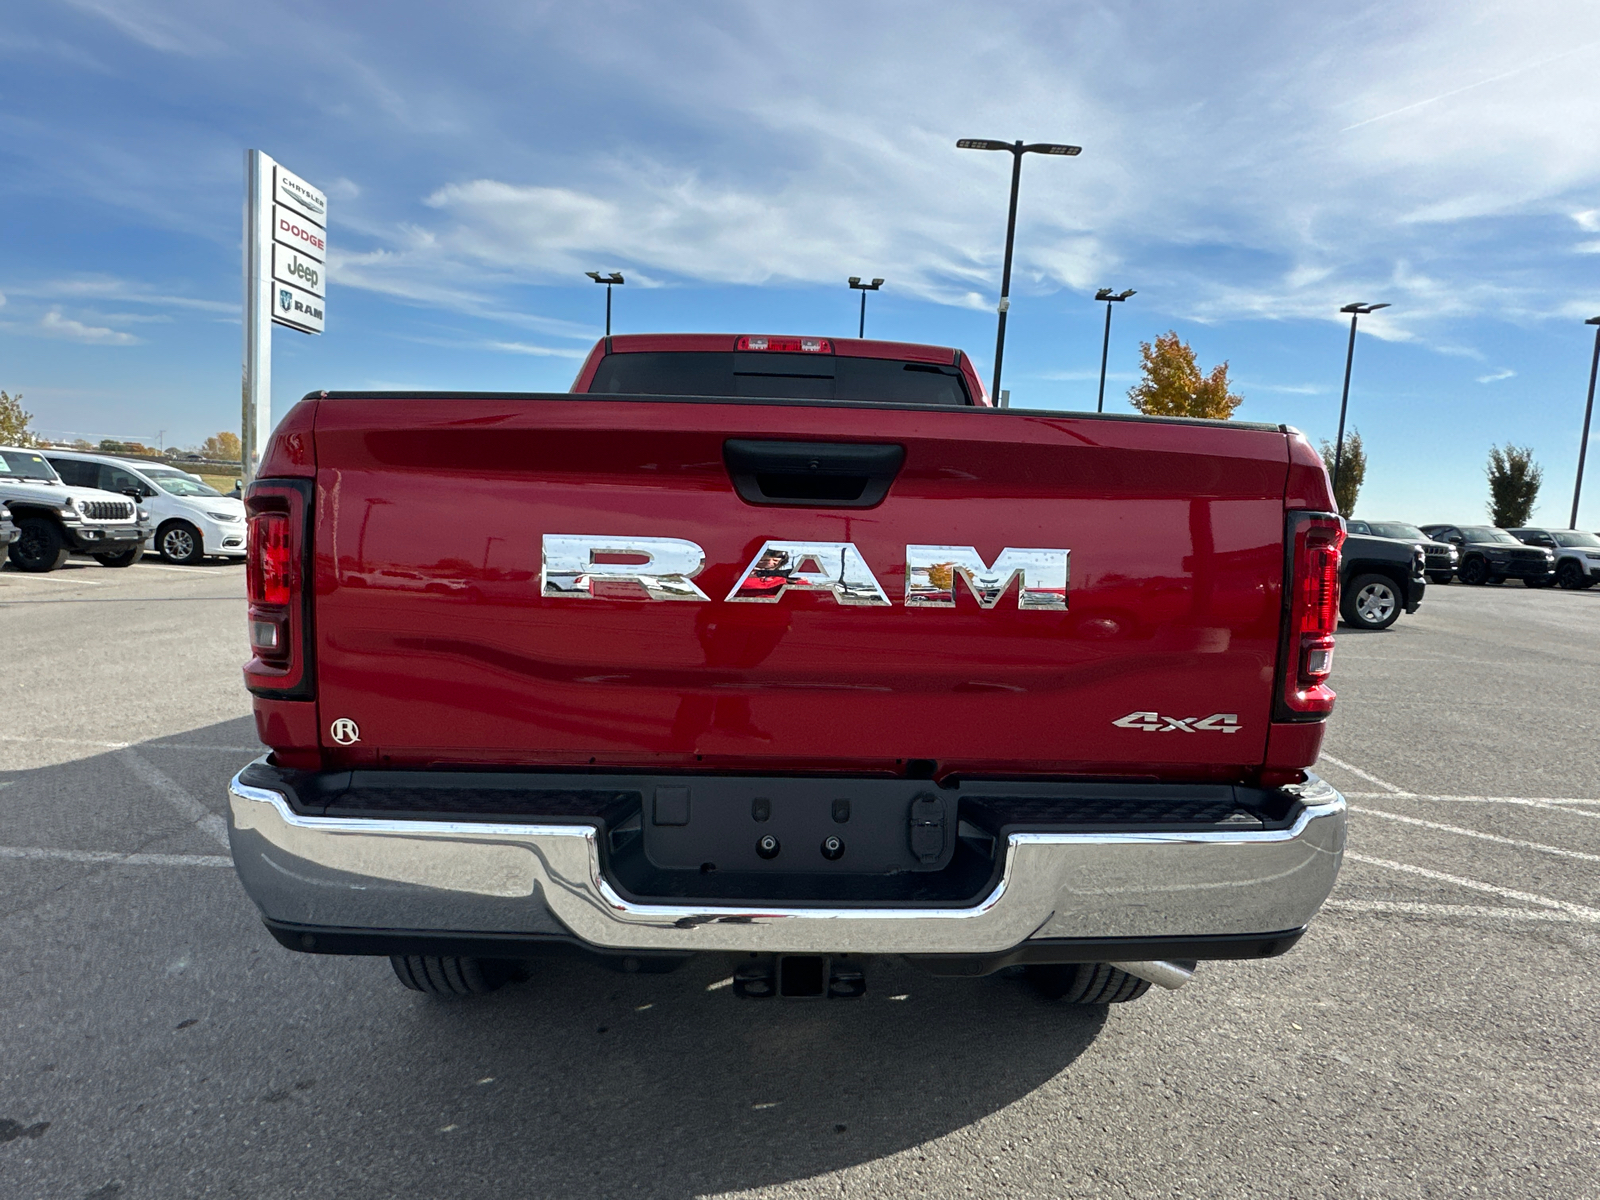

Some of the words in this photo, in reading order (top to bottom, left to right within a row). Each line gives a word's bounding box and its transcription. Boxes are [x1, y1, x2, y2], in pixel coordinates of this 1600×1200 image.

[282, 177, 324, 208] CHRYSLER
[280, 218, 324, 251] DODGE
[287, 255, 318, 288] Jeep
[294, 299, 323, 320] RAM
[541, 533, 1072, 610] RAM
[1112, 711, 1243, 733] 4x4
